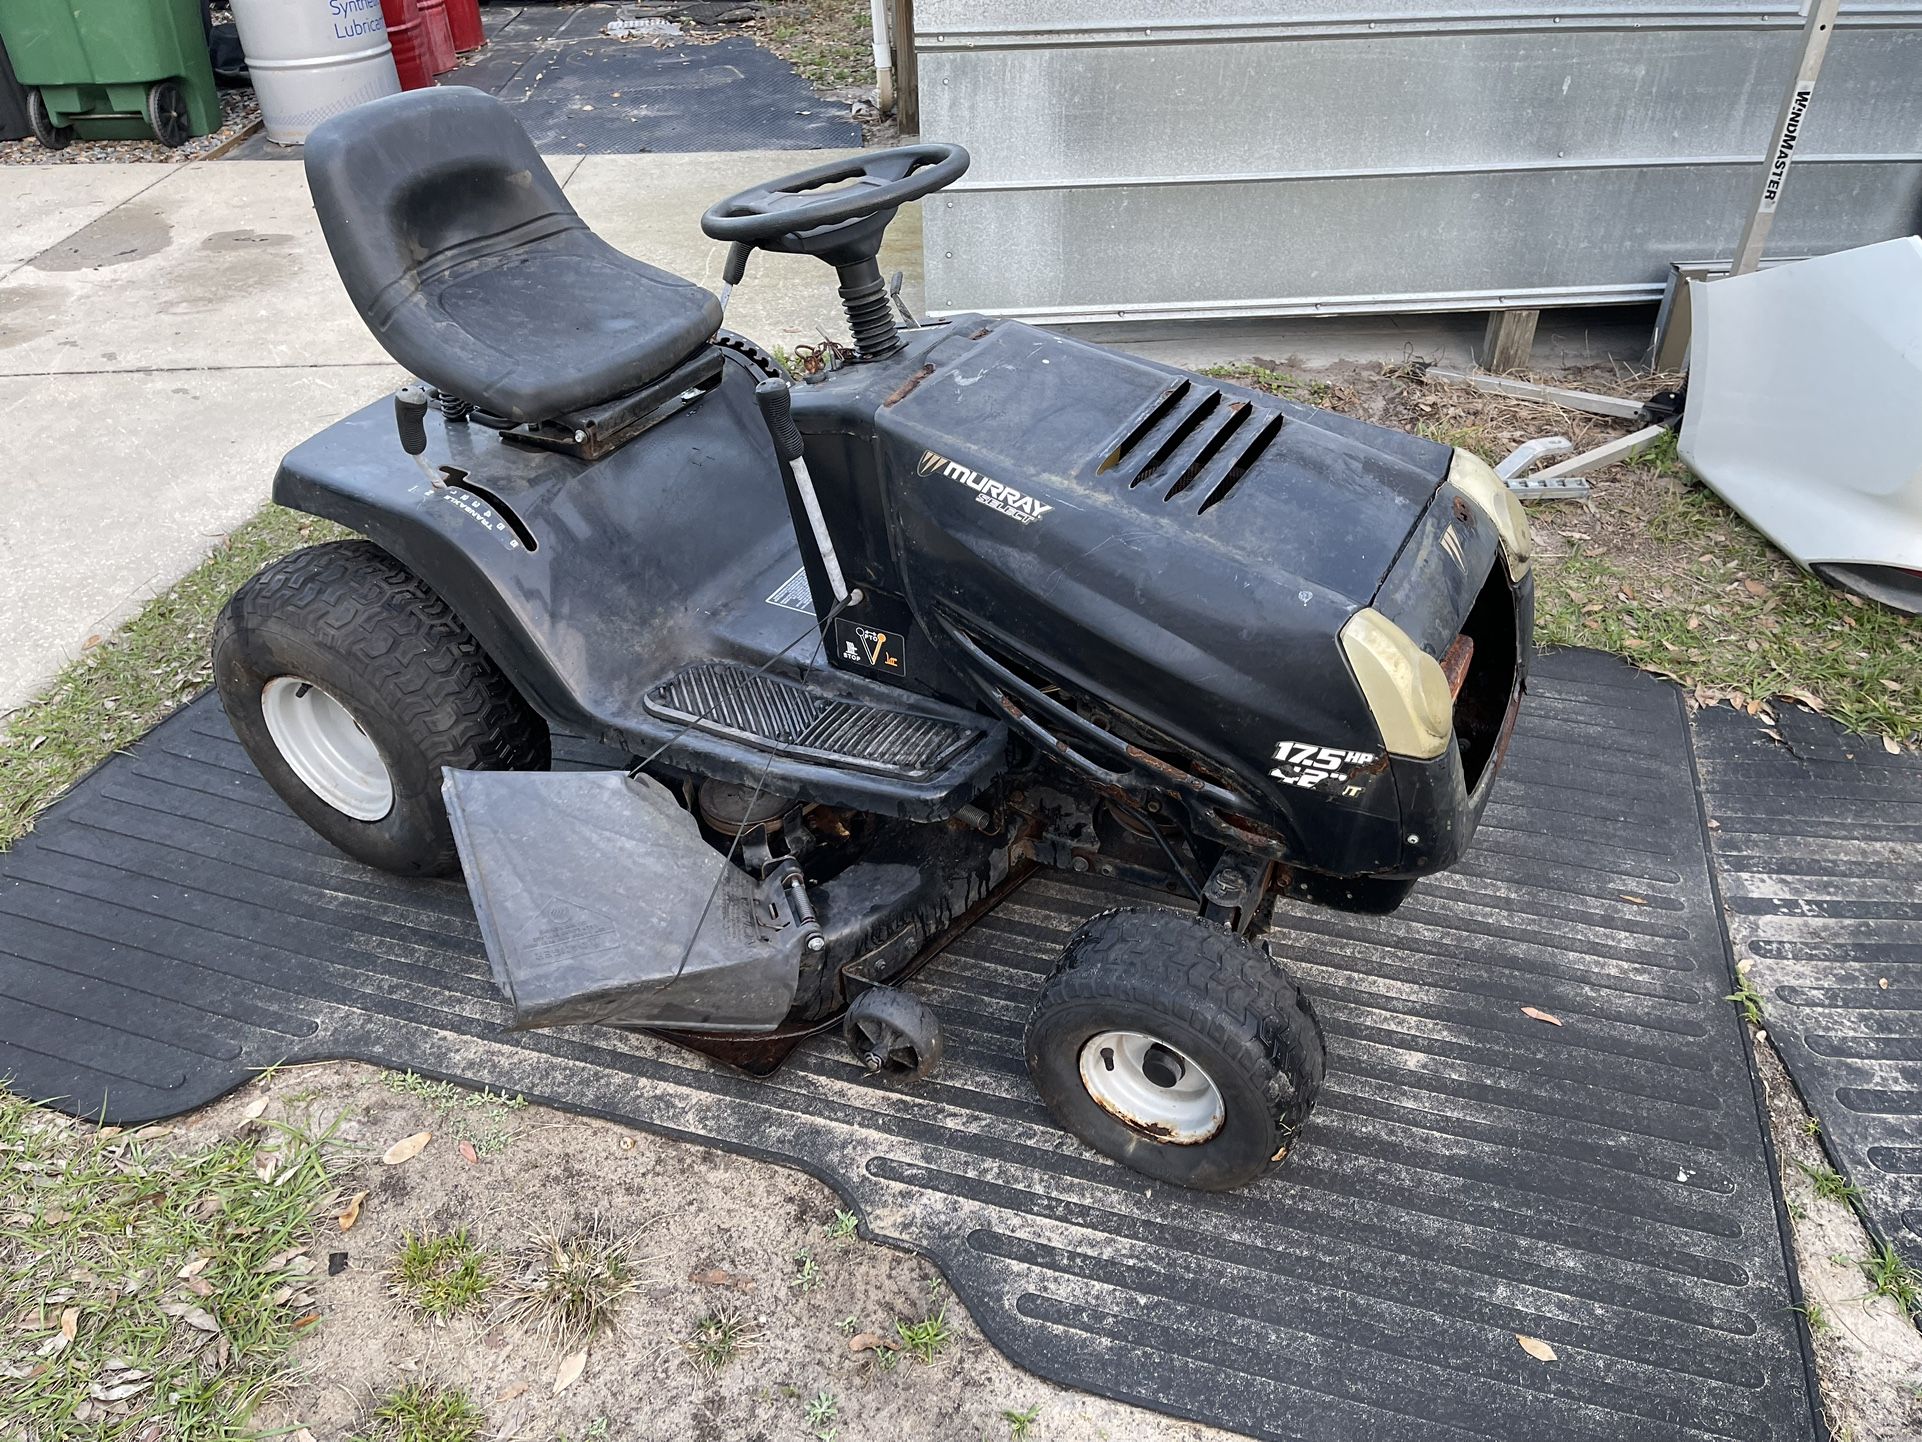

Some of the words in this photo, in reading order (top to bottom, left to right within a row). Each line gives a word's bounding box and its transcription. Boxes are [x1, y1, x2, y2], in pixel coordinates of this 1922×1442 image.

[943, 461, 1054, 516] MURRAY
[443, 494, 493, 531] TRANSAXLE
[976, 493, 1034, 523] SELECT
[843, 652, 861, 662] STOP
